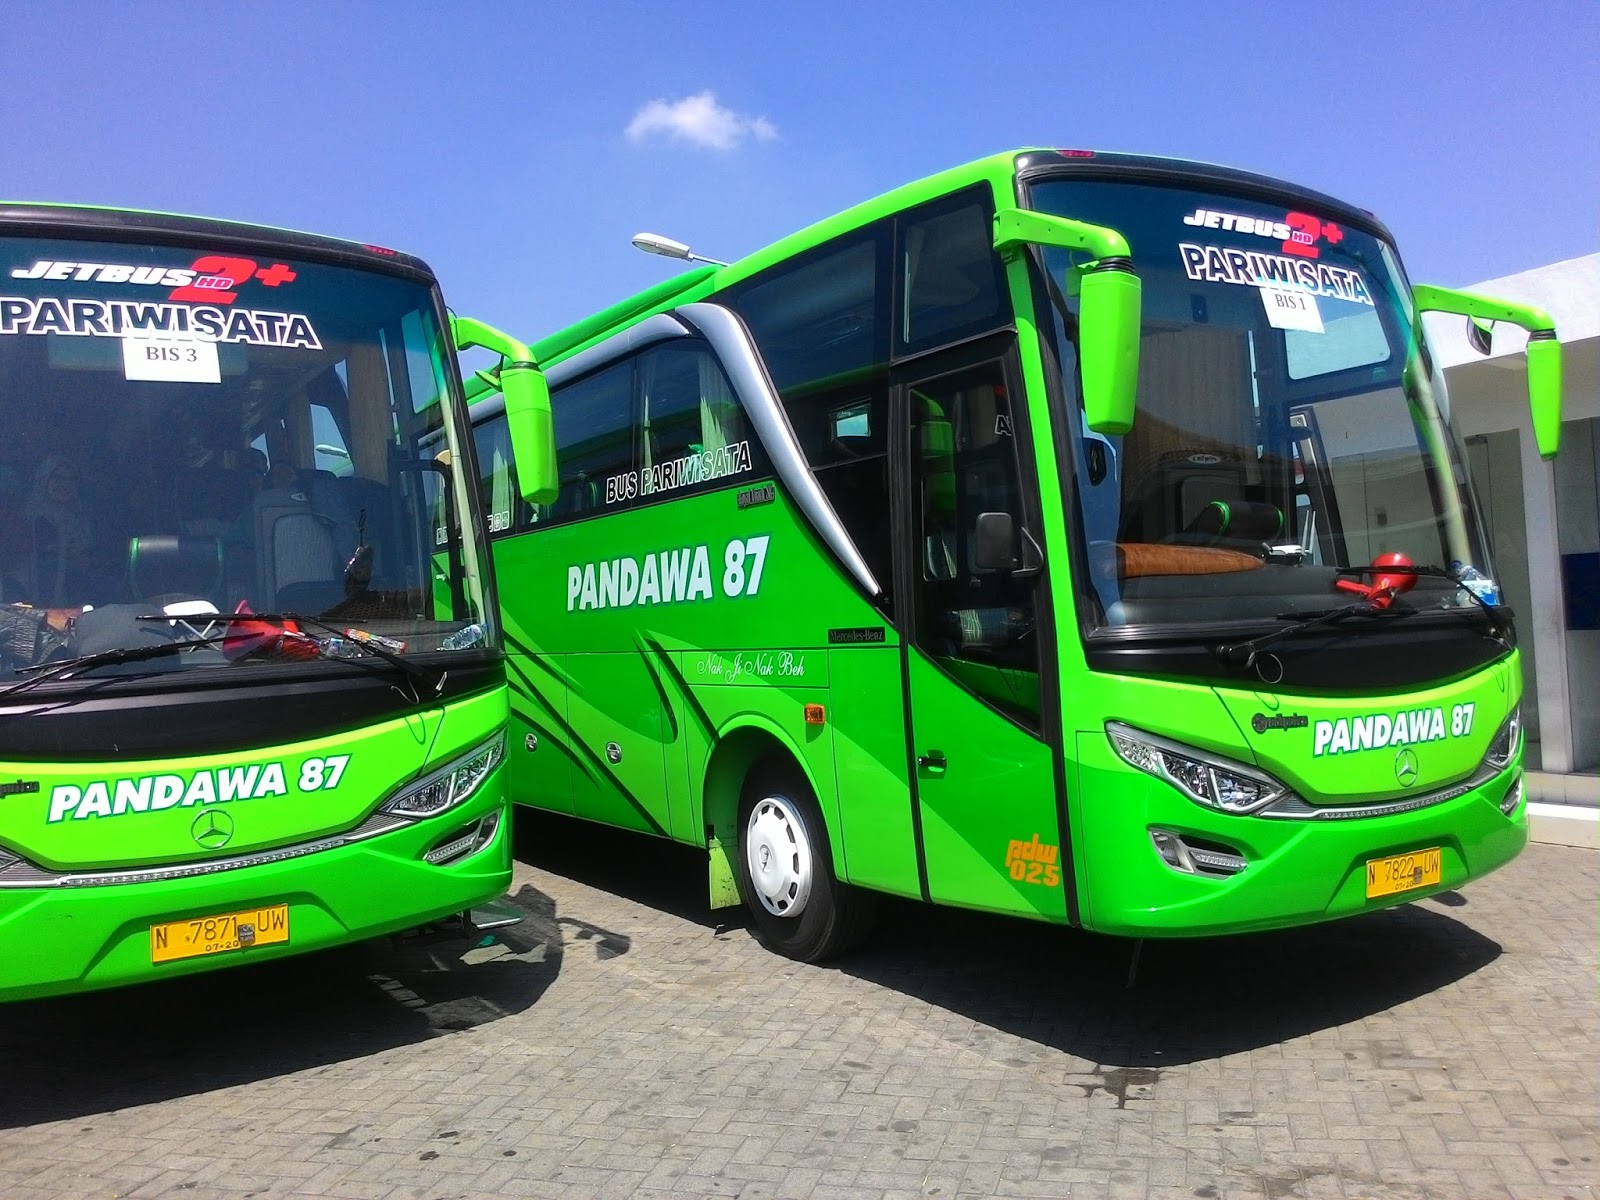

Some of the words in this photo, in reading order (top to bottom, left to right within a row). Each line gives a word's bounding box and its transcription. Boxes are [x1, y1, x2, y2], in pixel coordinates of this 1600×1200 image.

[1183, 209, 1291, 240] JETBUS
[11, 260, 198, 287] JETBUS
[1178, 243, 1375, 306] PARIWISATA
[1274, 293, 1297, 310] BIS
[1299, 297, 1307, 311] 1
[0, 296, 323, 350] PARIWISATA
[145, 346, 180, 362] BIS
[186, 348, 198, 362] 3
[606, 471, 638, 504] BUS
[640, 441, 753, 496] PARIWISATA
[566, 545, 714, 612] PANDAWA
[721, 535, 771, 598] 87
[830, 629, 884, 642] Mercedes-Benz
[1313, 707, 1446, 758] PANDAWA
[1450, 702, 1475, 738] 87
[46, 762, 287, 825] PANDAWA
[297, 753, 354, 793] 87
[1010, 860, 1060, 887] 025
[1368, 863, 1376, 887] N
[1384, 856, 1415, 881] 7822
[1423, 850, 1440, 874] UW
[155, 926, 168, 949] N
[189, 915, 238, 944] 7871
[256, 907, 286, 932] UW
